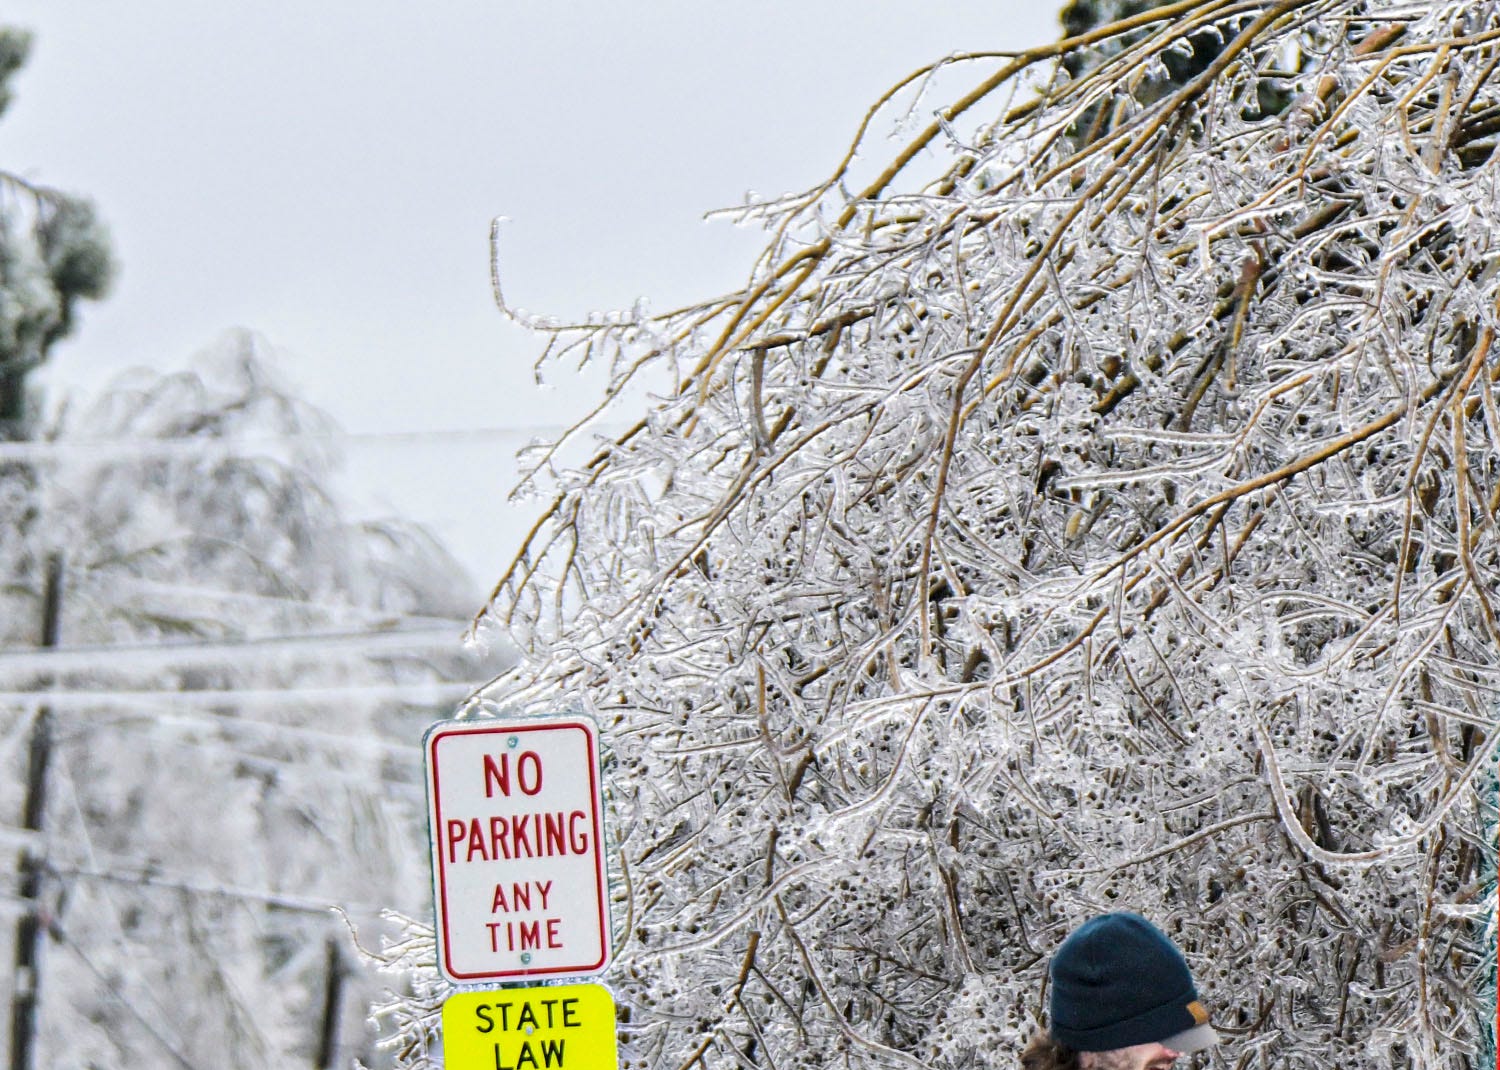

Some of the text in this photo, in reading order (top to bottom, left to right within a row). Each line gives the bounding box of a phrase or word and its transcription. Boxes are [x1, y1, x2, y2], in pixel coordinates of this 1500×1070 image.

[483, 751, 543, 797] NO
[447, 810, 588, 863] PARKING
[492, 880, 553, 913] ANY
[486, 918, 563, 952] TIME
[475, 998, 581, 1033] STATE
